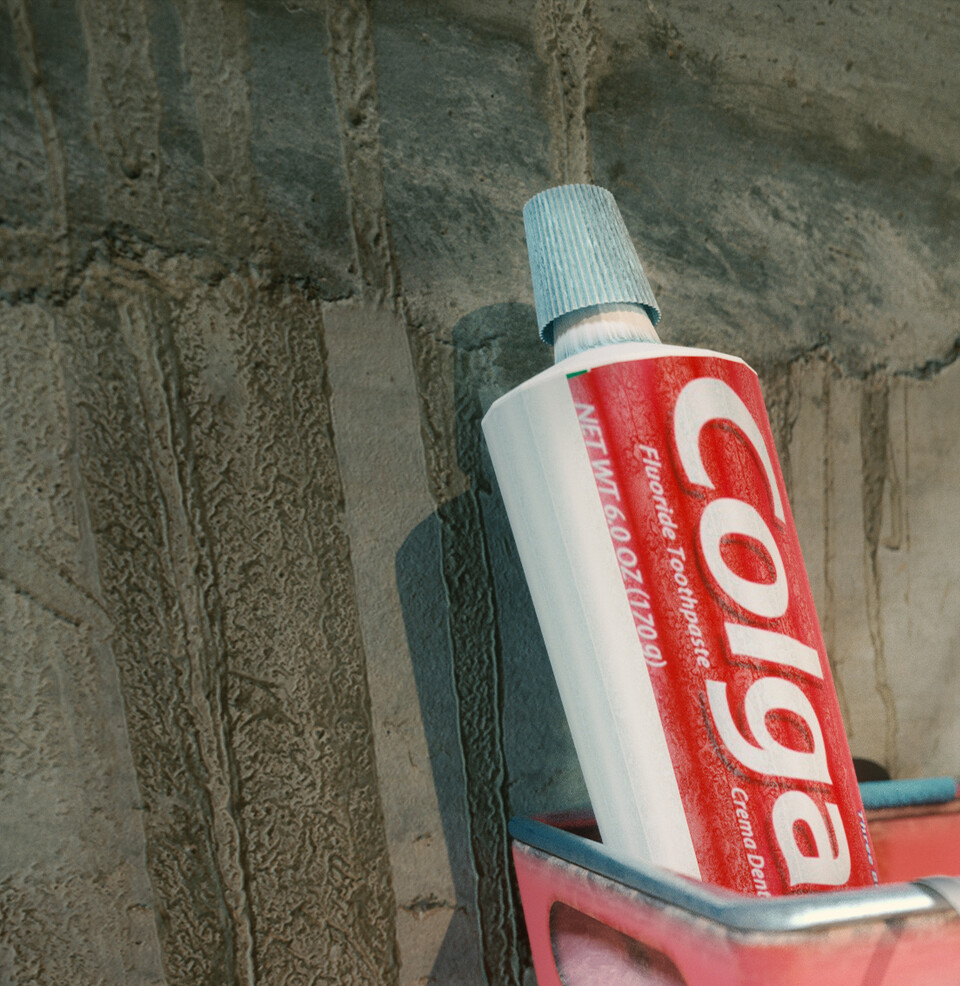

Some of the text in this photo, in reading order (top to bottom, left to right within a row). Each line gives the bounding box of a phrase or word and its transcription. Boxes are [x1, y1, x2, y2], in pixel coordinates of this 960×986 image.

[575, 403, 608, 455] NET
[592, 459, 620, 502] WT
[604, 504, 631, 543] 6.0
[617, 546, 643, 585] OZ
[638, 443, 711, 669] Fluoride Toothpaste
[626, 588, 658, 640] (170
[673, 376, 852, 888] Colga
[731, 787, 757, 850] Crema
